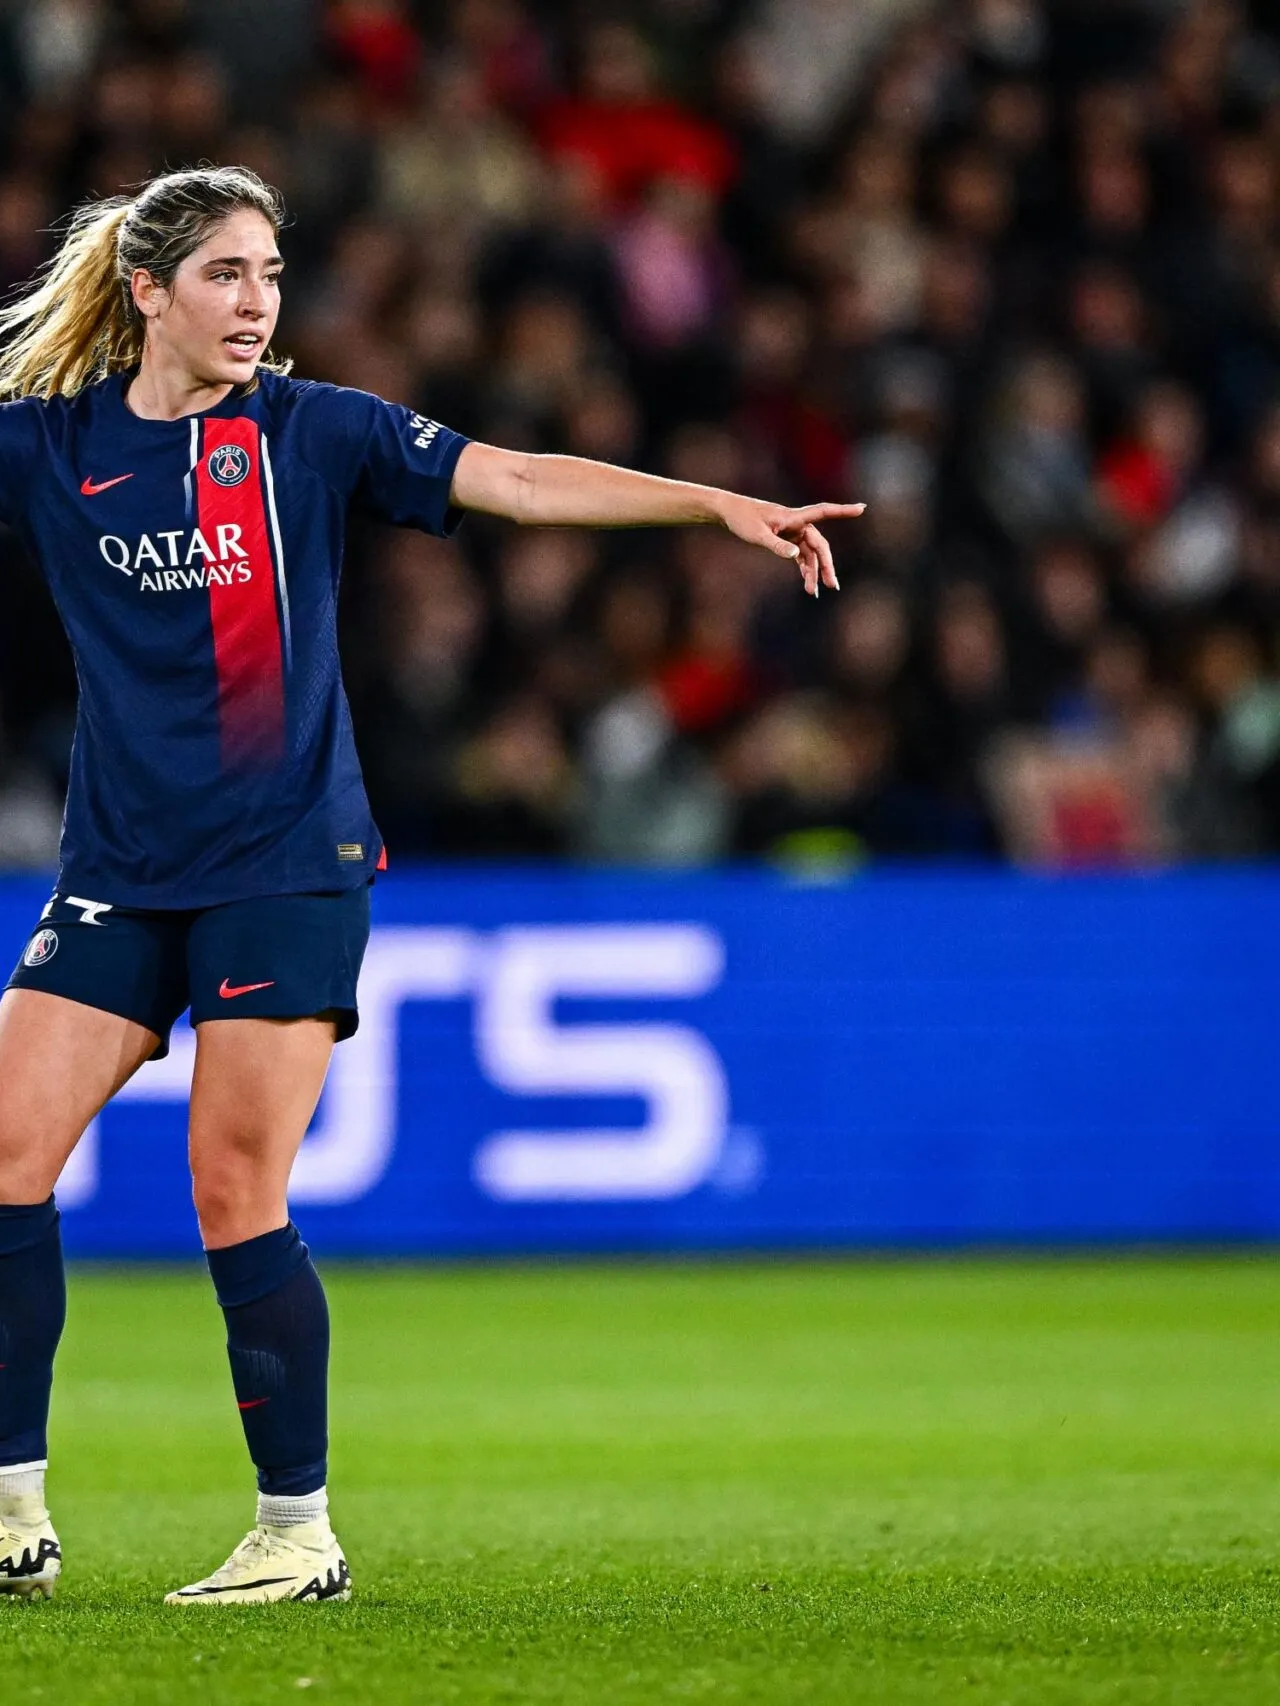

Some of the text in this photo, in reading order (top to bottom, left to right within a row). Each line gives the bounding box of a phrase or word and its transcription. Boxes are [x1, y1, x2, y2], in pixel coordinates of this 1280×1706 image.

[214, 446, 241, 459] PARIS
[99, 523, 249, 577] QATAR
[140, 560, 252, 592] AIRWAYS
